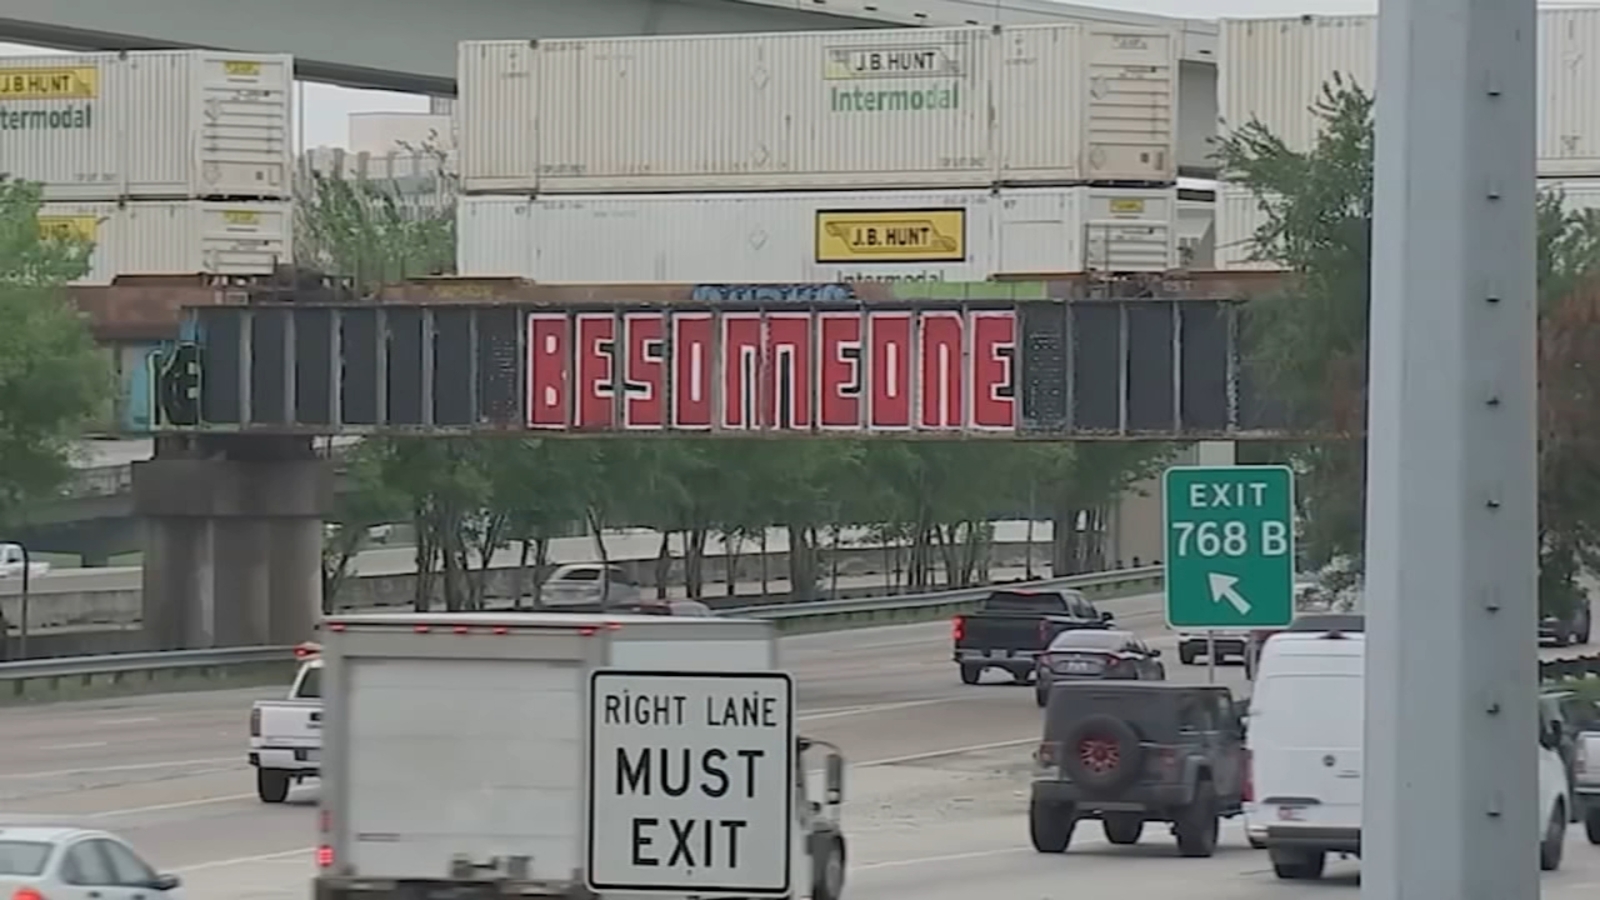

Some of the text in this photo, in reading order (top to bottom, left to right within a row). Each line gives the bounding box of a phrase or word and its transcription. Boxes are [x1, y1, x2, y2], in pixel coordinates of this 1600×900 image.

[888, 52, 936, 71] HUNT
[28, 74, 70, 92] HUNT
[831, 80, 959, 111] Intermodal
[853, 227, 930, 246] J.B. HUNT
[1190, 482, 1268, 507] EXIT
[1172, 521, 1288, 557] 768 B
[605, 694, 777, 728] RIGHT LANE
[616, 747, 765, 798] MUST
[632, 818, 748, 869] EXIT
